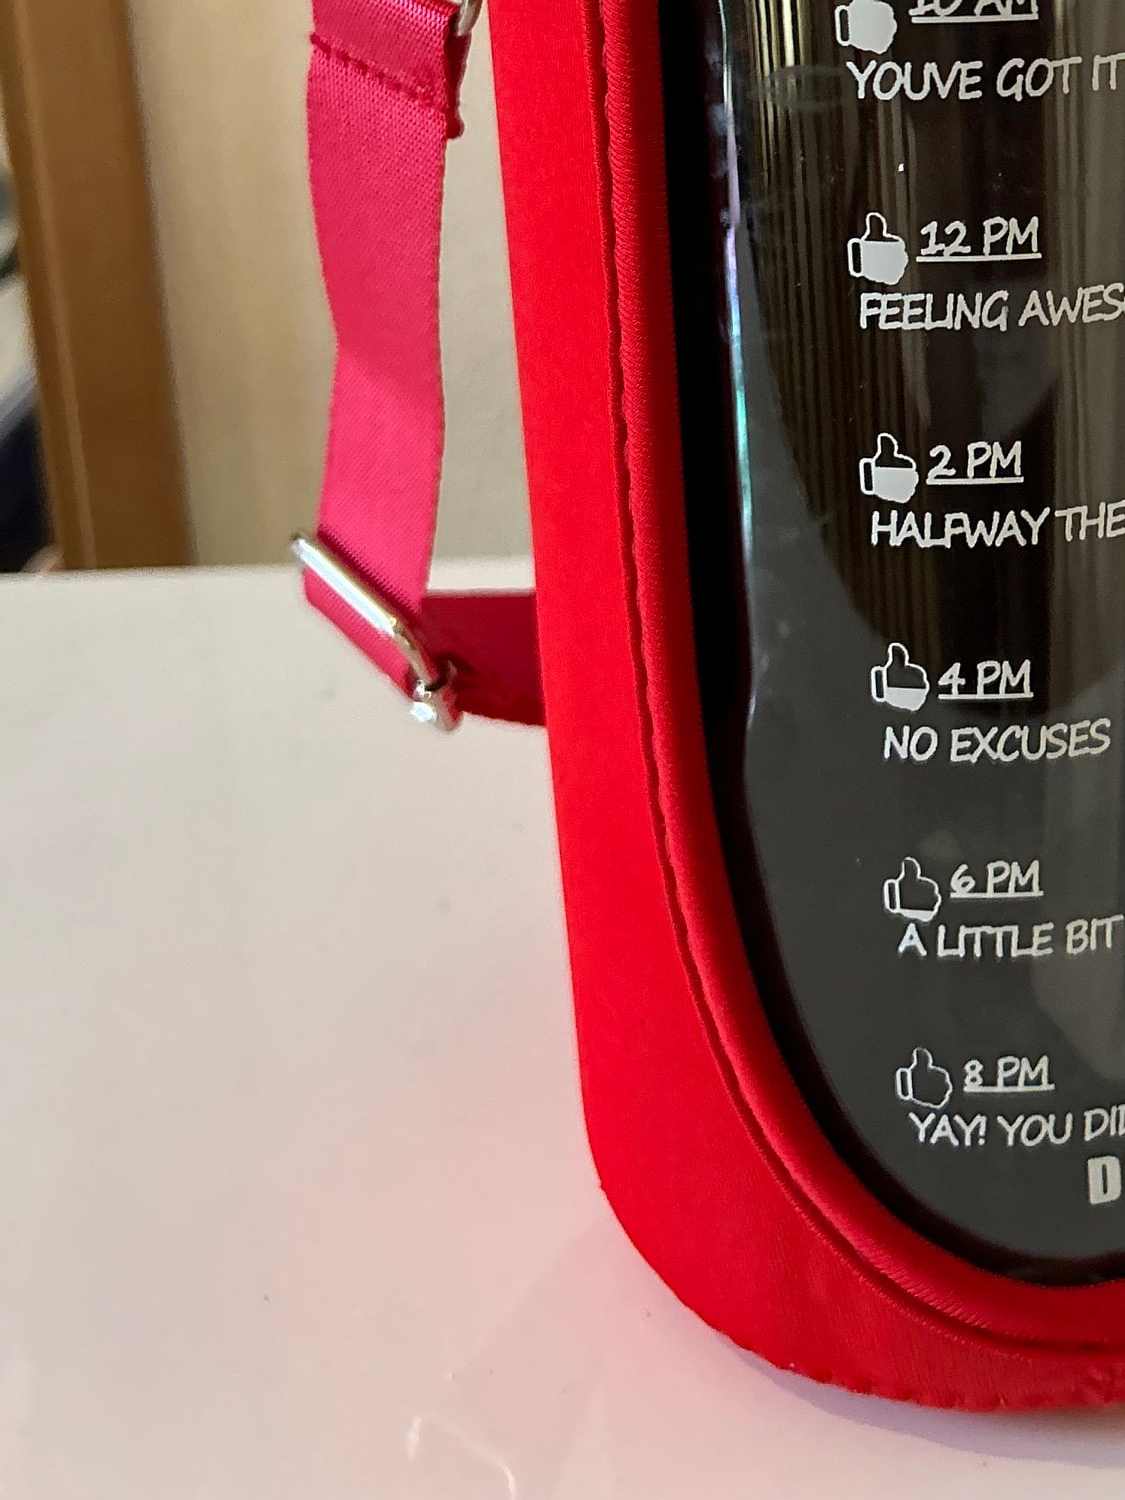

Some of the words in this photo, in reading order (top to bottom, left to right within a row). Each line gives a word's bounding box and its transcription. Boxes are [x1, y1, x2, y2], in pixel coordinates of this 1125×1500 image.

[846, 60, 983, 100] YOUVE
[997, 56, 1082, 101] GOT
[920, 220, 971, 255] 12
[982, 216, 1039, 256] PM
[859, 290, 1009, 332] FEELING
[927, 445, 957, 479] 2
[966, 441, 1022, 479] PM
[871, 506, 1050, 549] HALFWAY
[938, 662, 966, 697] 4
[976, 659, 1032, 697] PM
[884, 725, 938, 762] NO
[950, 717, 1111, 764] EXCUSES
[950, 864, 976, 895] 6
[987, 859, 1040, 896] PM
[898, 922, 927, 957] A
[937, 921, 1054, 958] LITTLE
[1065, 914, 1124, 955] BIT
[963, 1059, 984, 1087] 8
[997, 1055, 1050, 1088] PM
[908, 1111, 987, 1147] YAY!
[997, 1111, 1073, 1147] YOU
